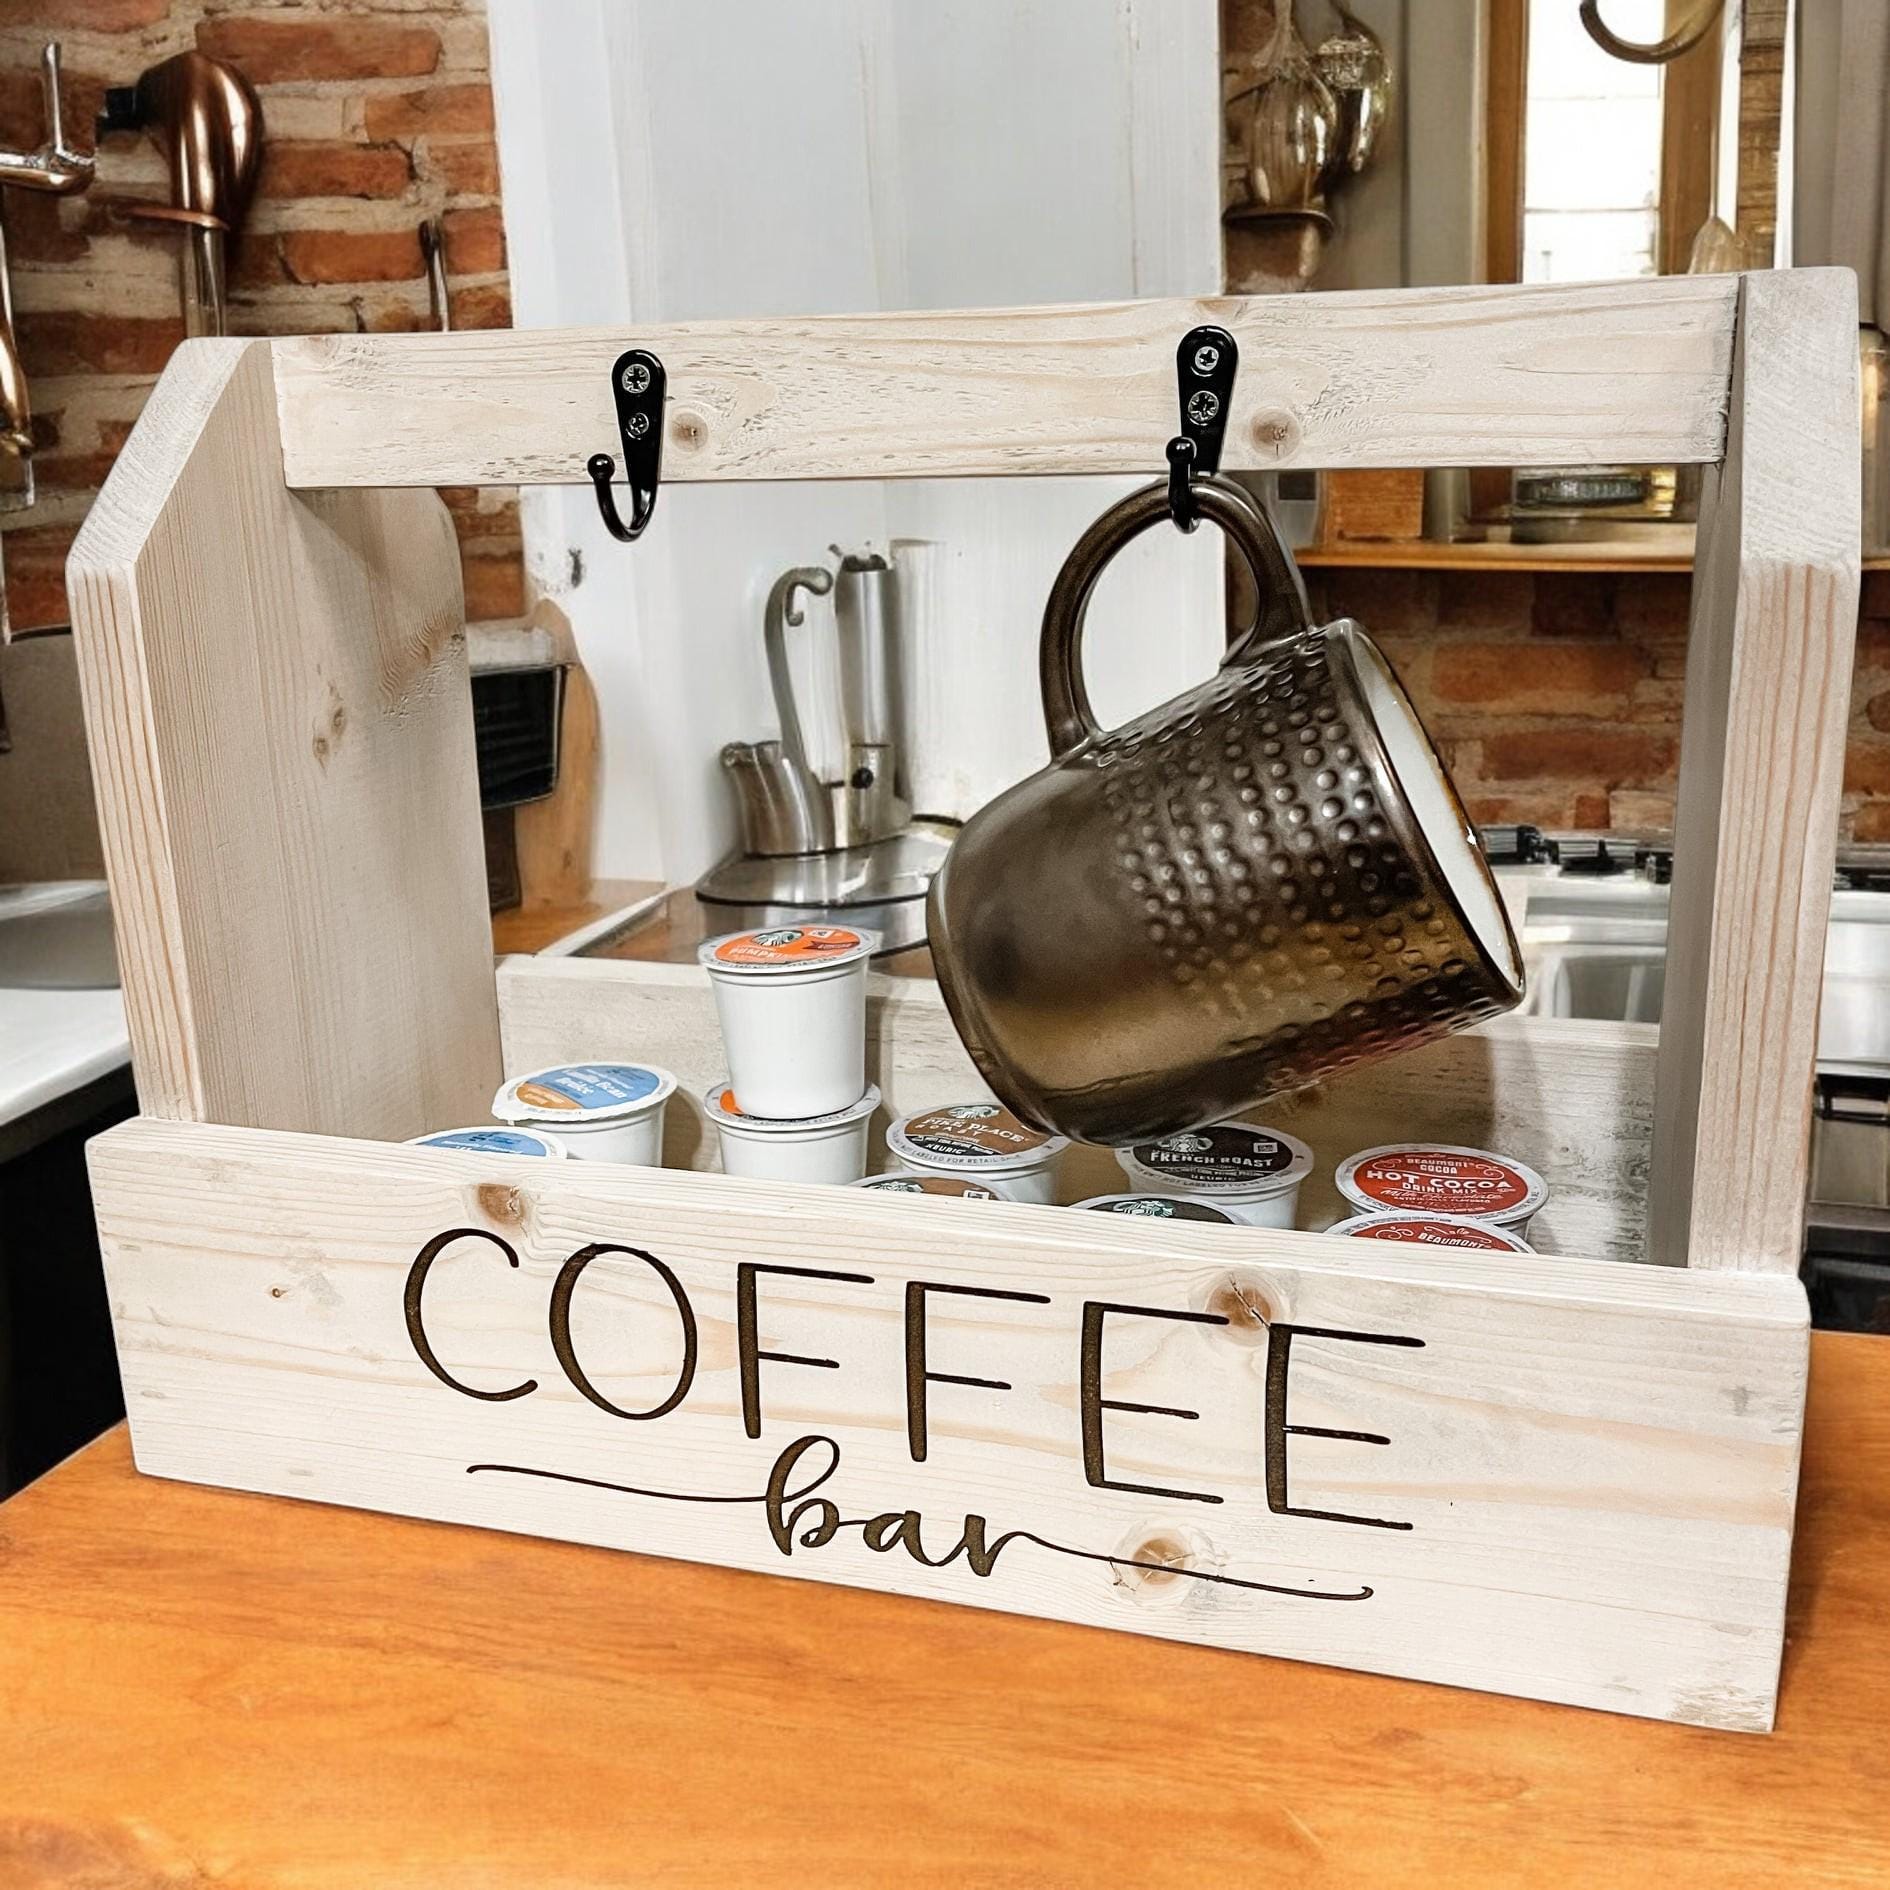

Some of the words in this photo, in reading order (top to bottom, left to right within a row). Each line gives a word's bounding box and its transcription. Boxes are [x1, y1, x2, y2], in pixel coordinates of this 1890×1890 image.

[967, 1122, 1026, 1144] PLACE
[925, 1143, 967, 1155] KEURIG
[1150, 1151, 1215, 1164] FRENCH
[1220, 1156, 1273, 1168] ROAST
[1419, 1163, 1458, 1175] COCOA
[1366, 1169, 1420, 1185] HOT
[1430, 1178, 1513, 1190] COCOA
[1402, 1182, 1445, 1195] DRINK
[1451, 1187, 1478, 1195] MIX
[1417, 1232, 1484, 1249] BEAUMONT
[403, 1228, 1426, 1530] COFFEE
